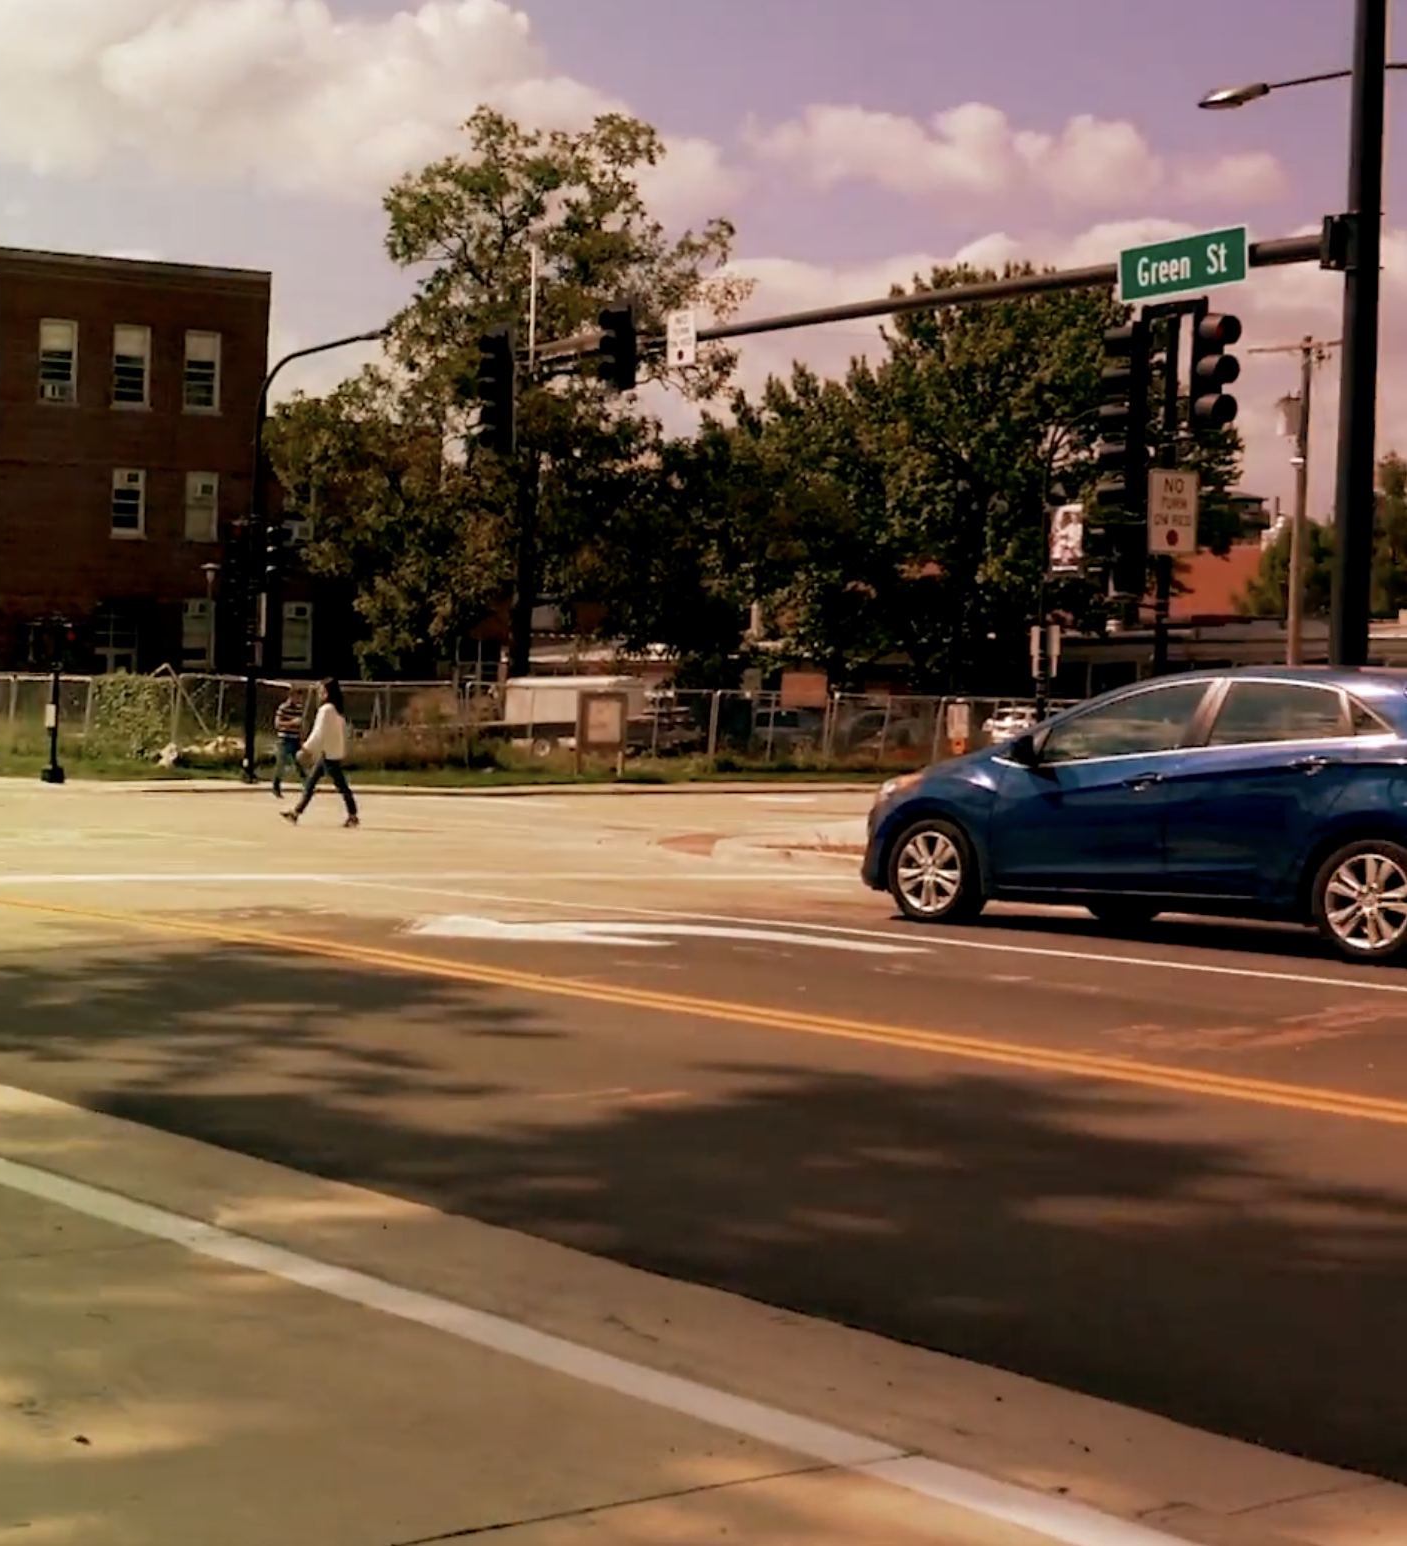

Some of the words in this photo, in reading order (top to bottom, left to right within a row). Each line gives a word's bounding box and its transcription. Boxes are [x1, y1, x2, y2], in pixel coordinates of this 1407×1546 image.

[1137, 257, 1191, 287] Green
[1206, 242, 1228, 275] St
[1164, 477, 1185, 494] NO
